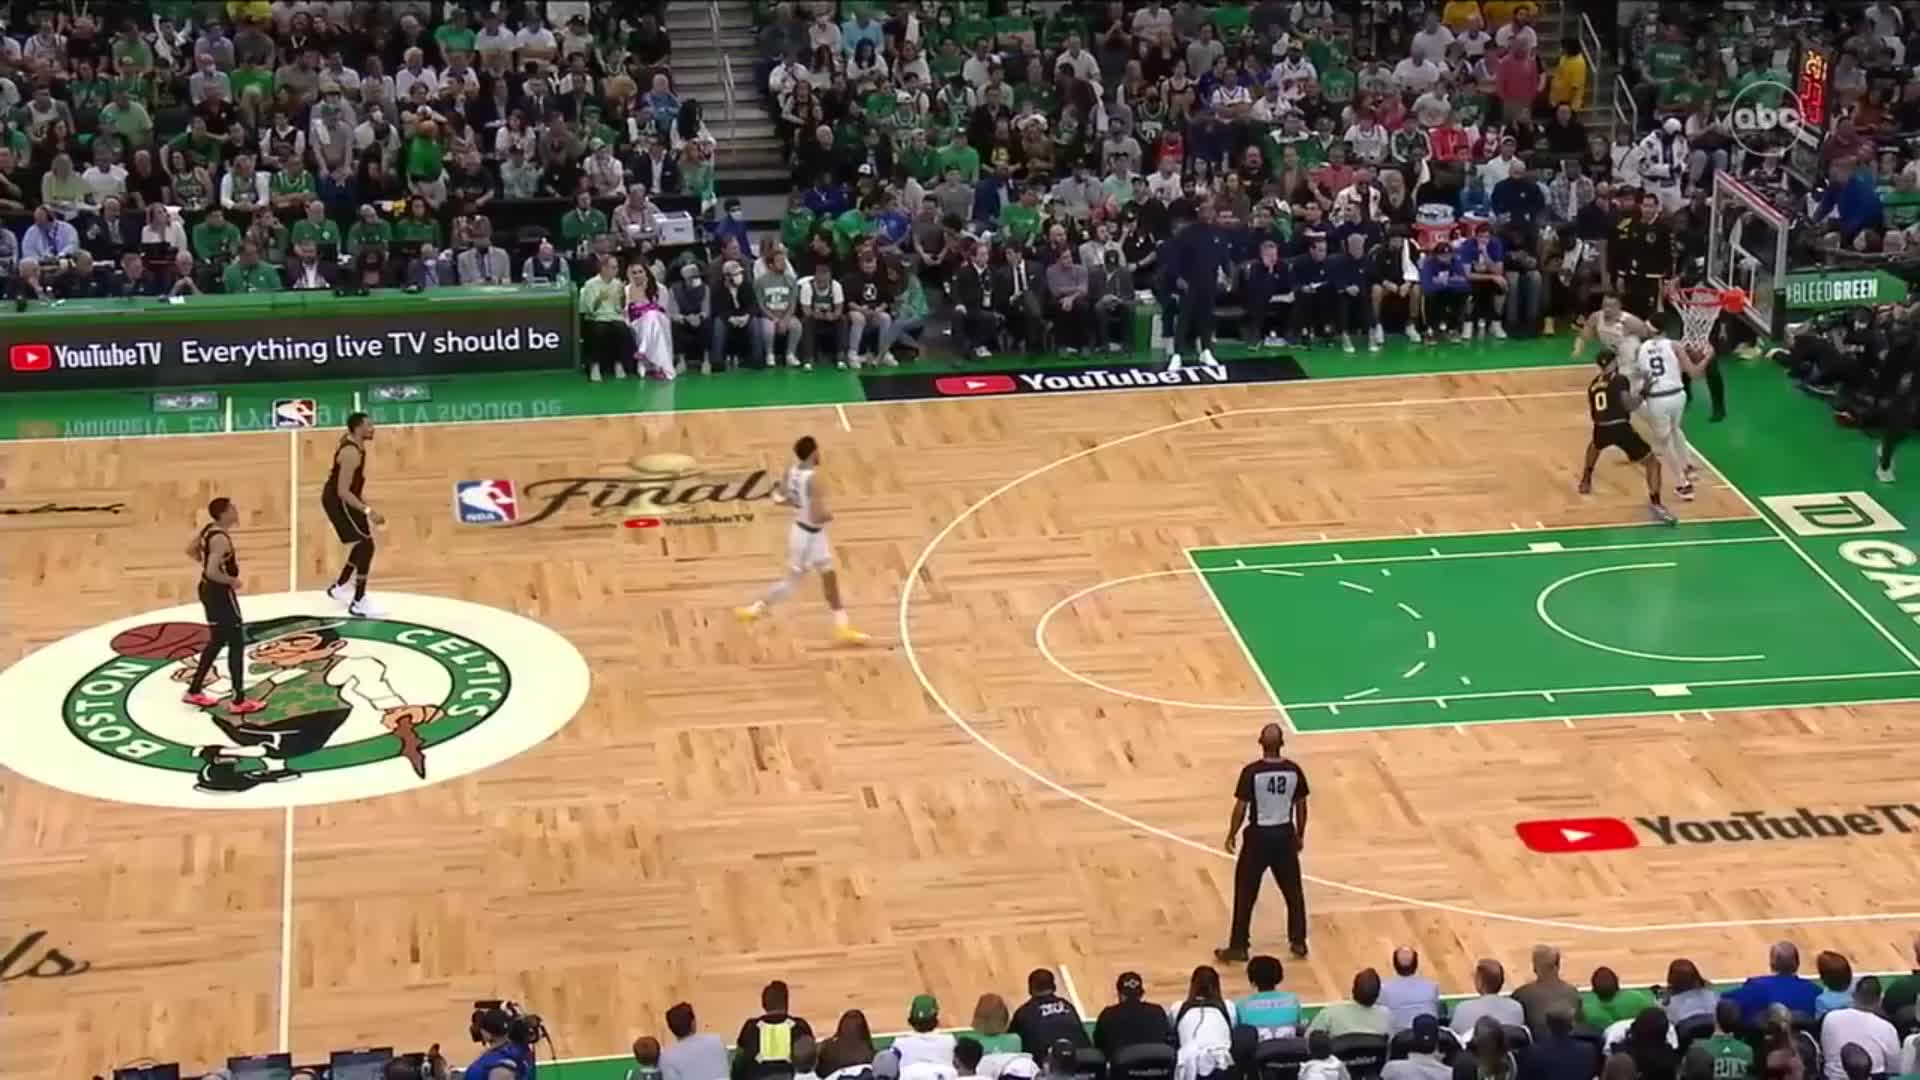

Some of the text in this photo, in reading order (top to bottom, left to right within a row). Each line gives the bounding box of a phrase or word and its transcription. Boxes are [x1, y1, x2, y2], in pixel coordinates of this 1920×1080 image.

[181, 336, 328, 367] Everything
[335, 334, 383, 357] live
[387, 331, 426, 354] TV
[432, 328, 520, 353] should
[527, 328, 560, 350] be
[1649, 356, 1665, 377] 9
[1594, 391, 1607, 411] 0
[74, 629, 502, 759] BOSTON CELTICS
